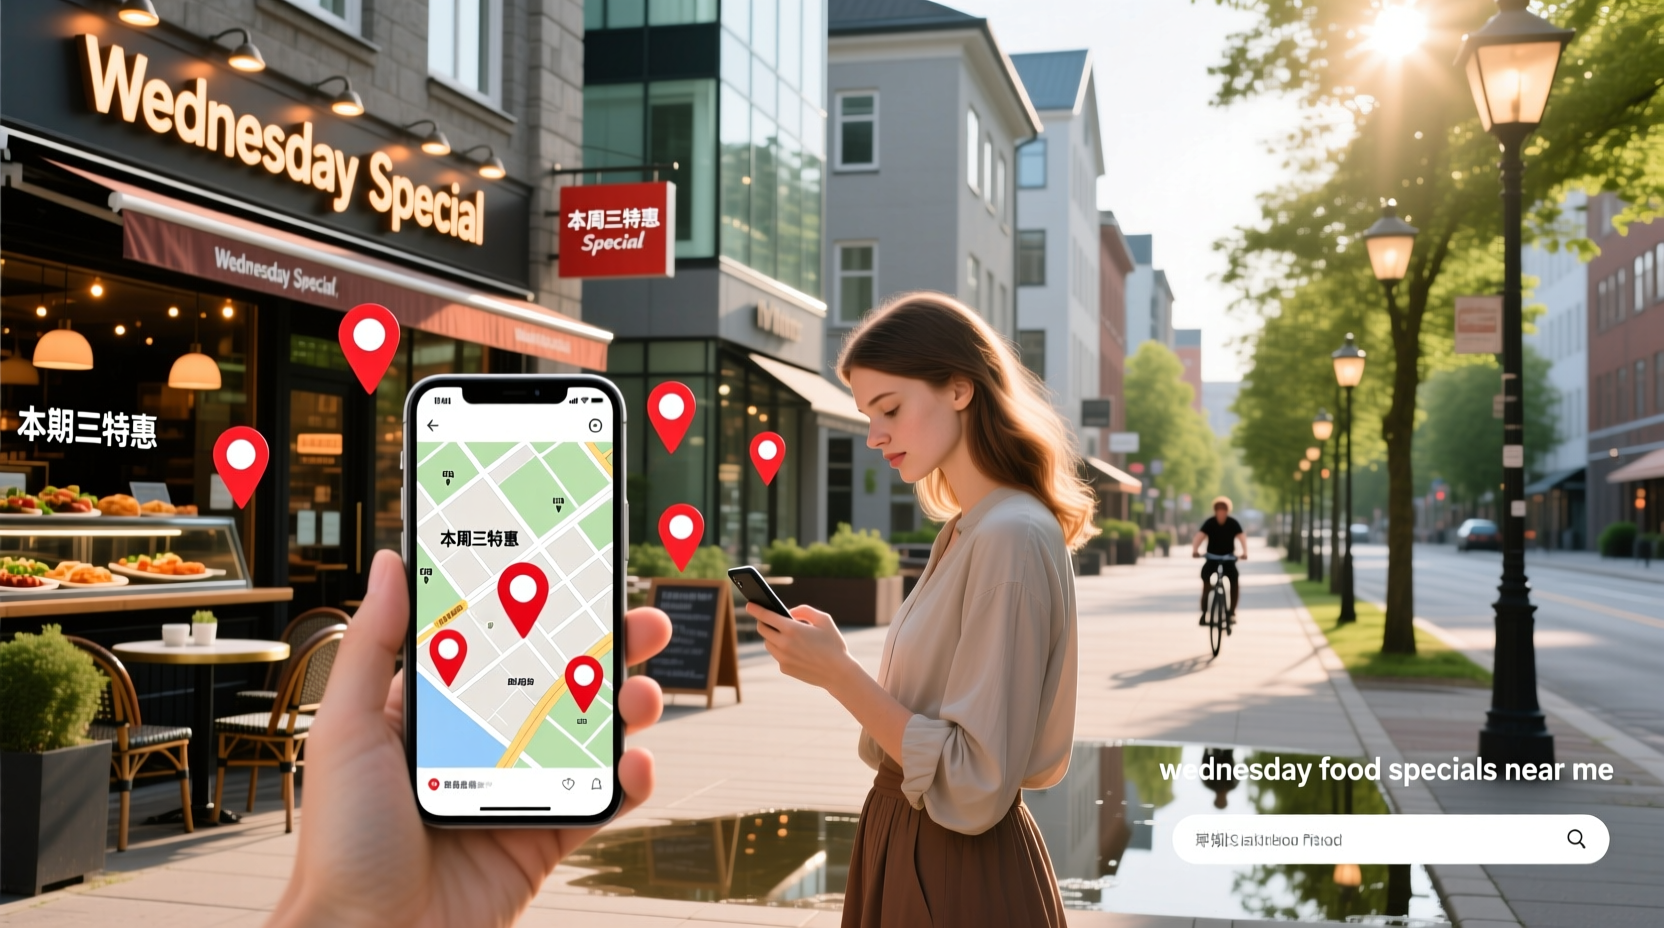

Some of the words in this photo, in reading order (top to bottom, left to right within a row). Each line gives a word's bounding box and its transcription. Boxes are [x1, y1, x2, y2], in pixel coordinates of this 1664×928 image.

[81, 33, 359, 212] Wednesday
[368, 151, 484, 246] Special
[567, 207, 661, 231] 本周三特惠
[581, 230, 646, 257] Special
[214, 246, 290, 289] Wednesday
[17, 405, 158, 450] 本期三特惠
